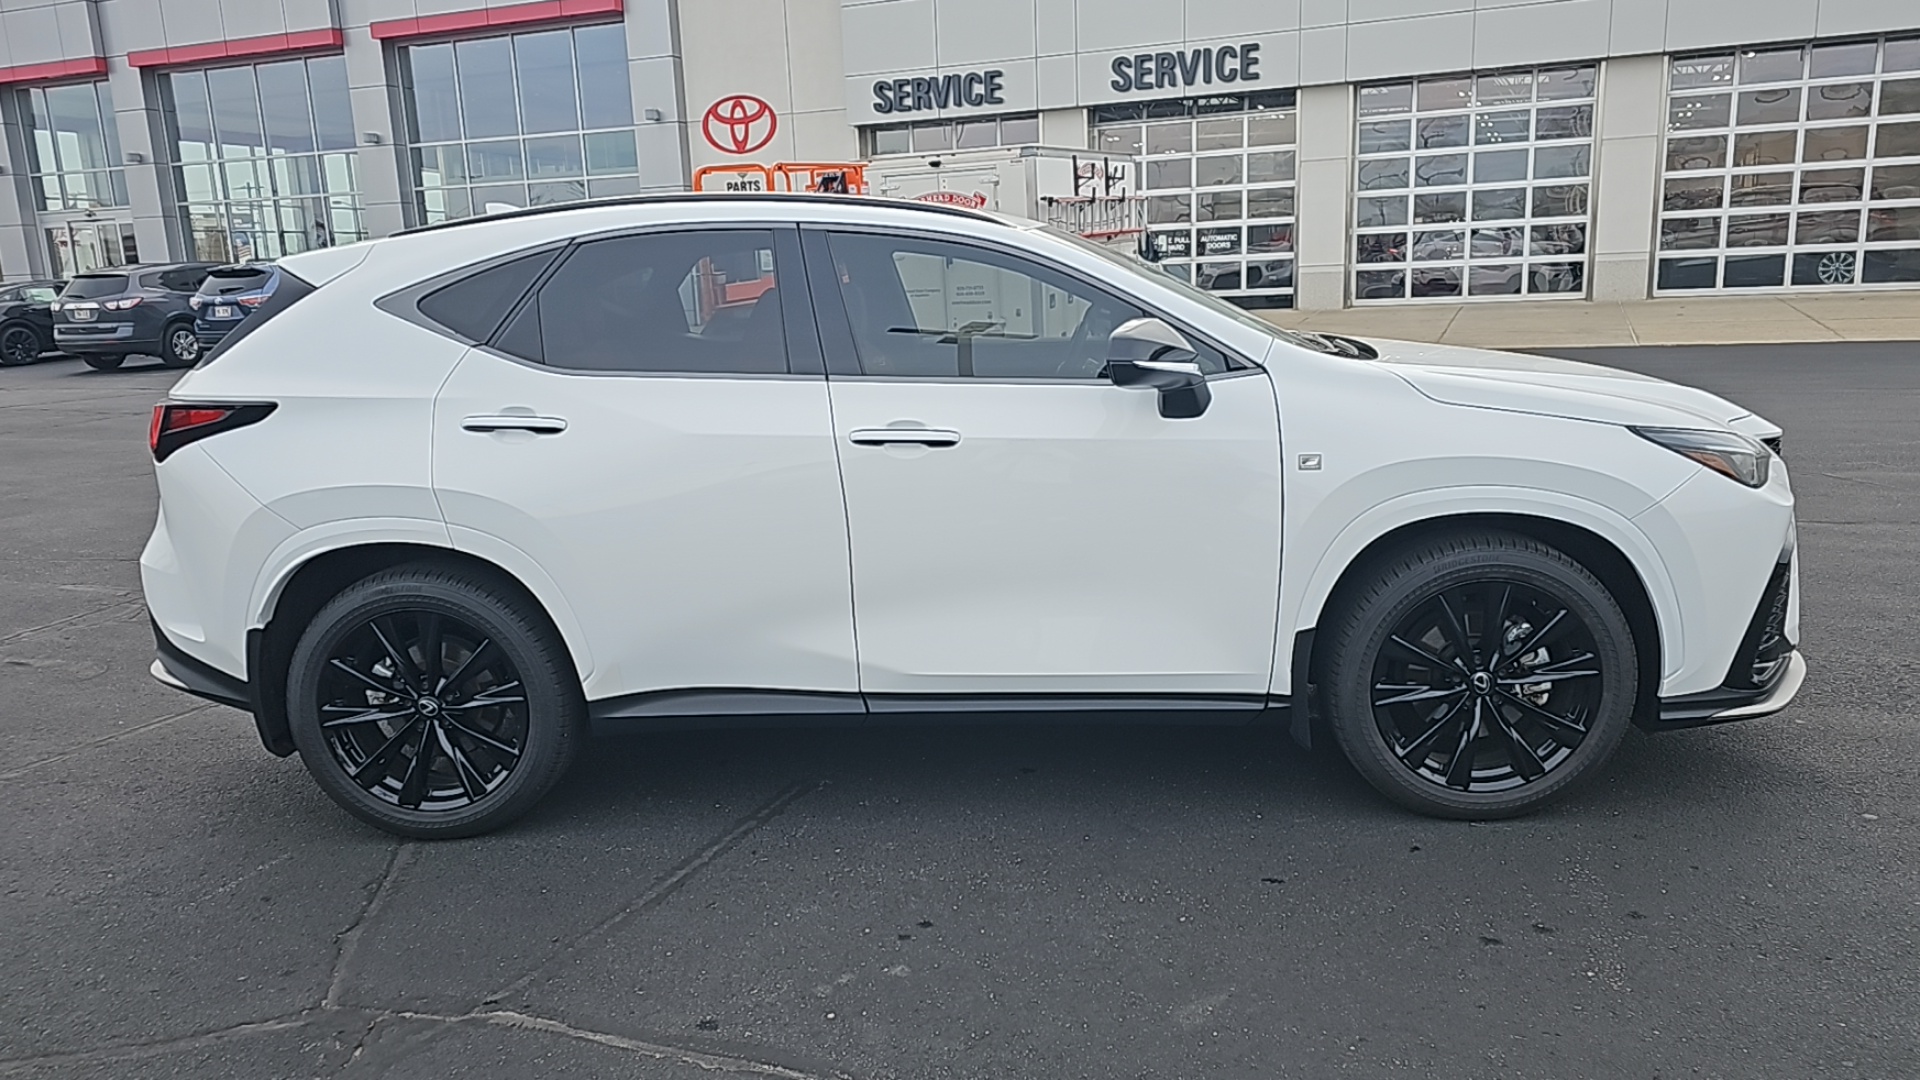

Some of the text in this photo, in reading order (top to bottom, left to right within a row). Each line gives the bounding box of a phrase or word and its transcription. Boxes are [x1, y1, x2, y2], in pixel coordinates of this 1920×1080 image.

[1111, 42, 1261, 93] SERVICE
[872, 70, 1005, 114] SERVICE
[726, 180, 761, 192] PARTS
[1174, 236, 1191, 244] PULL
[1200, 233, 1238, 243] AUTOMATIC
[1206, 241, 1231, 249] DOORS
